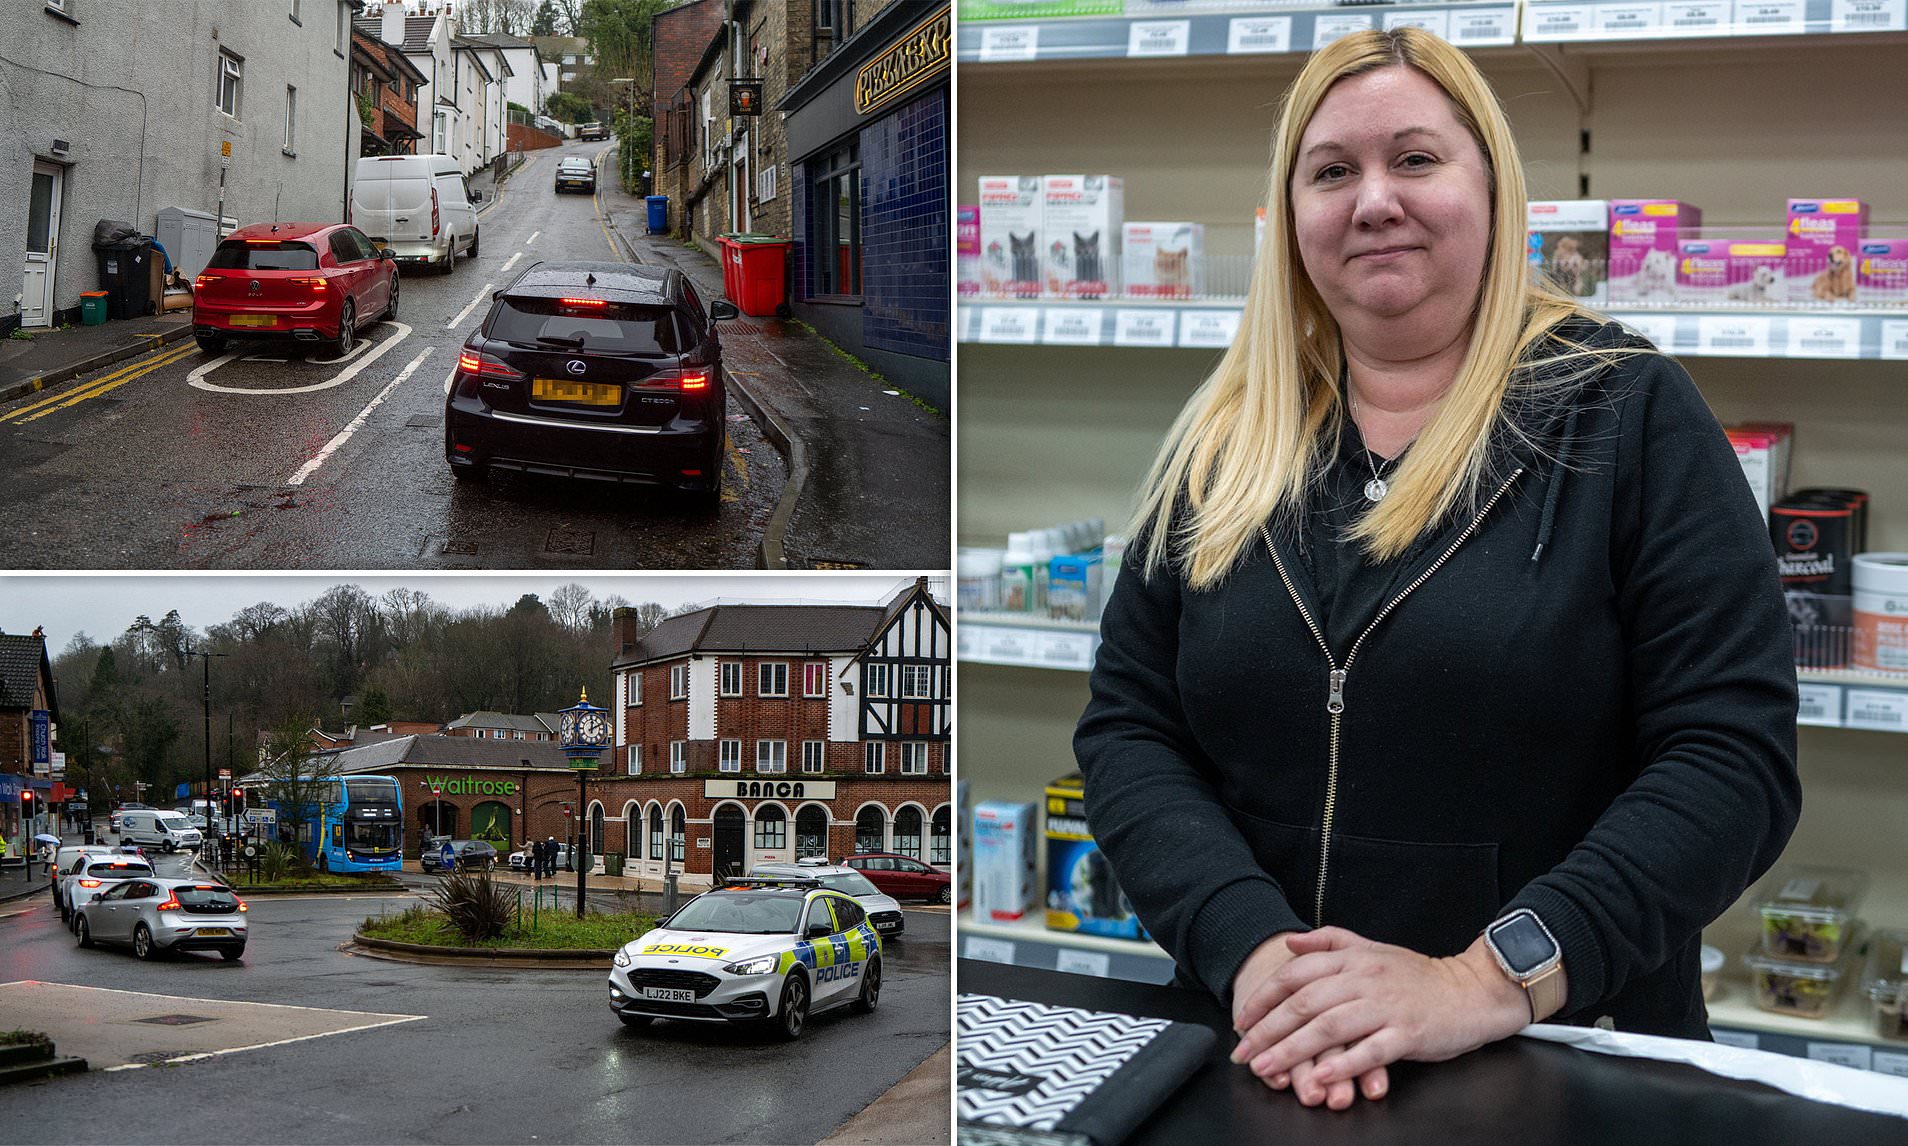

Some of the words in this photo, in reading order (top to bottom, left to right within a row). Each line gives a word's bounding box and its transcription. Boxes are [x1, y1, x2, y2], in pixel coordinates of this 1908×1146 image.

[483, 382, 510, 390] LEXUS
[1777, 553, 1834, 575] harcoal
[425, 774, 515, 796] Waitrose
[736, 781, 805, 798] BANCA
[816, 962, 860, 985] POLICE
[646, 988, 671, 1000] LJ22
[673, 990, 692, 1001] BKE
